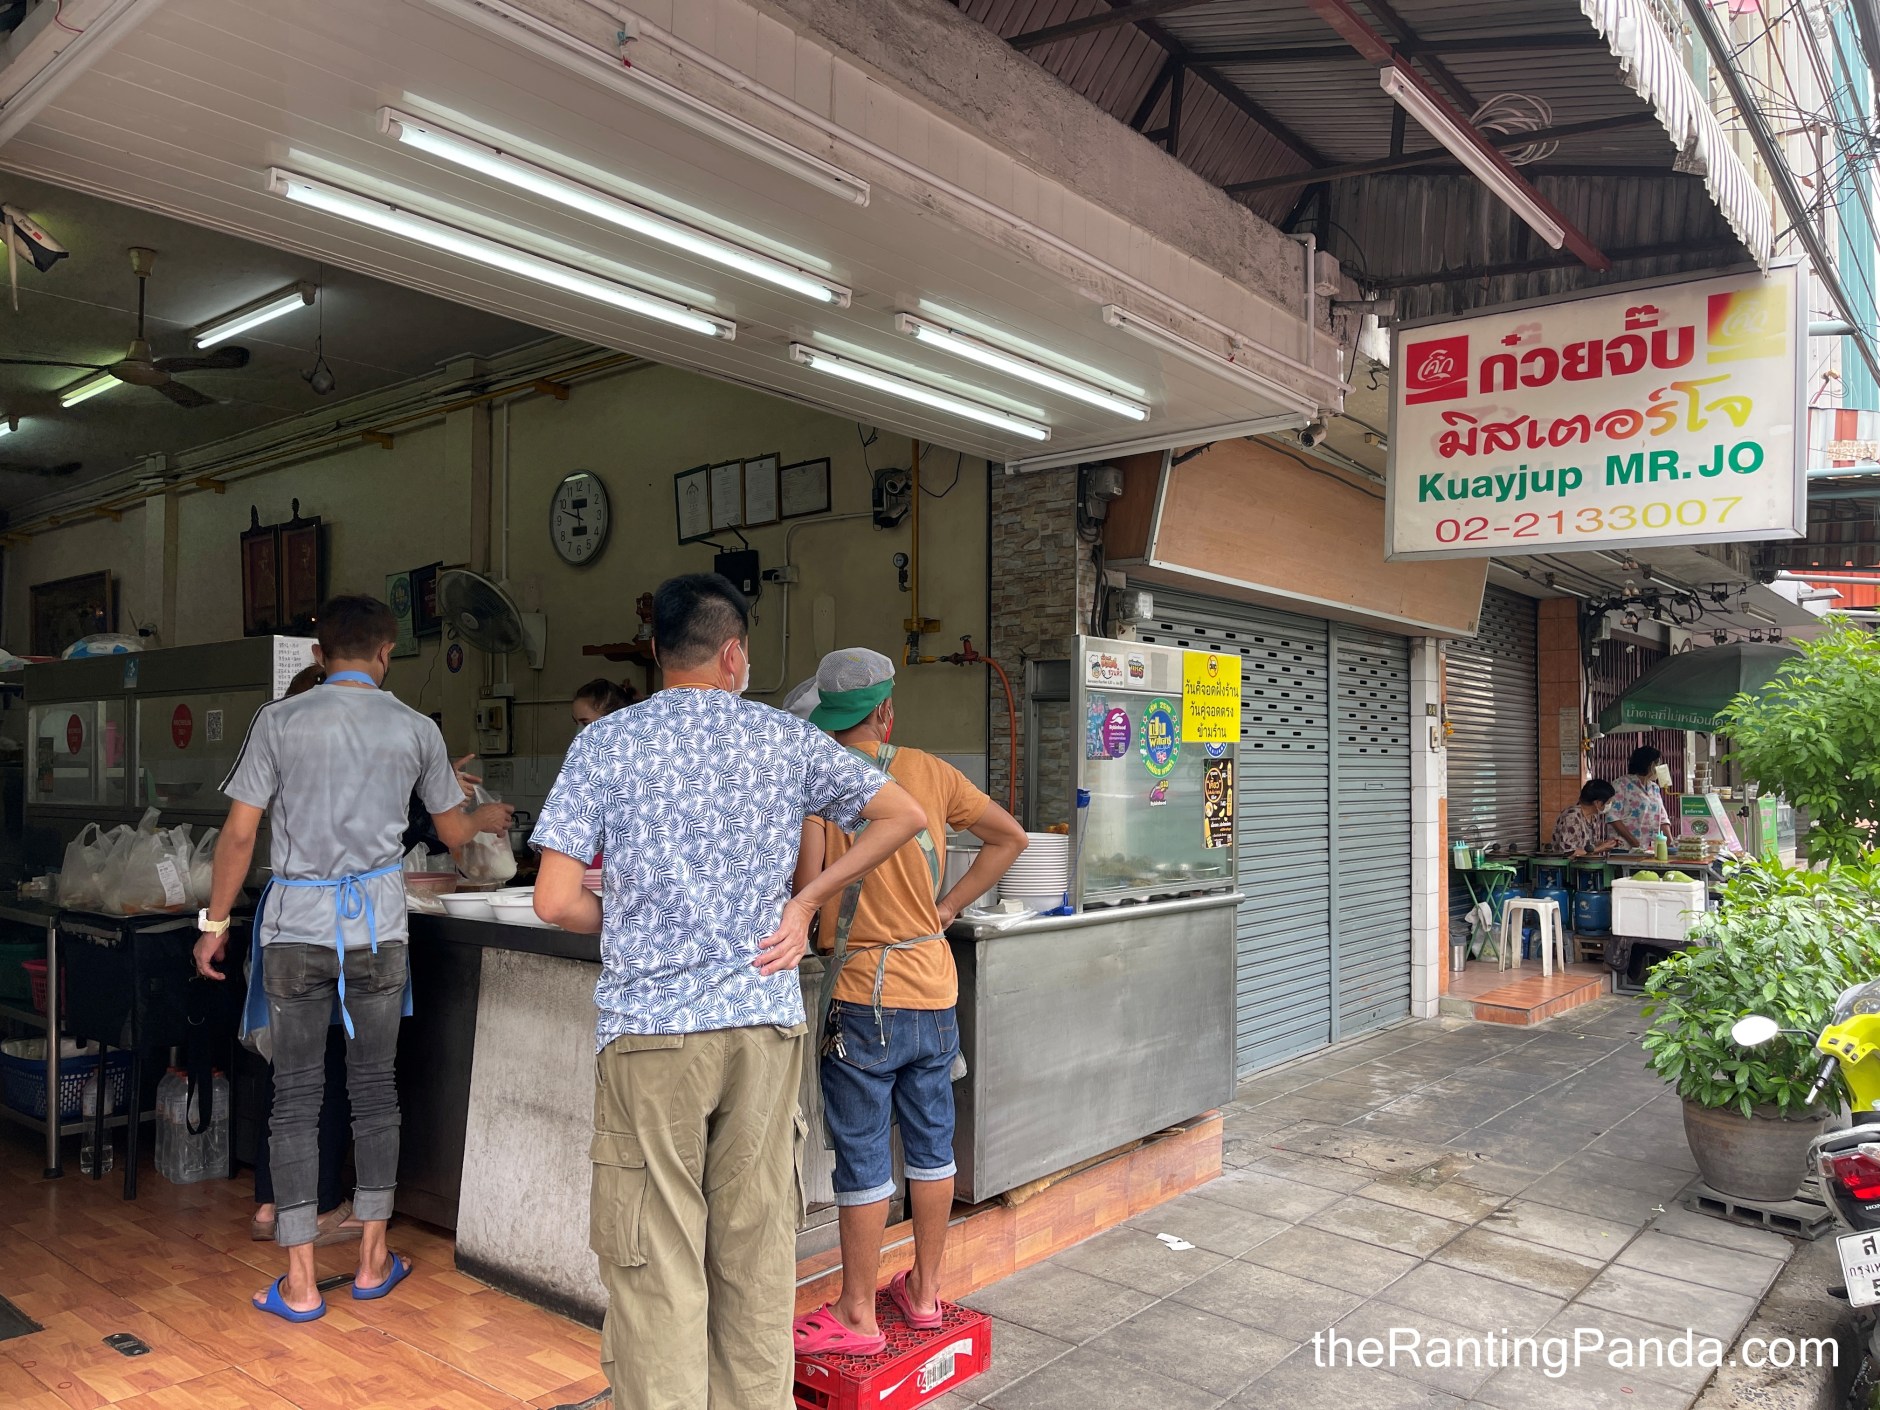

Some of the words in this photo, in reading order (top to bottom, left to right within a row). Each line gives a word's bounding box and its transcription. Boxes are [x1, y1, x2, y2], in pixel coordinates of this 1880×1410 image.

[1479, 304, 1696, 394] ก๋วยจั๊บ
[1438, 374, 1754, 458] มิสเตอร์โจ
[576, 480, 583, 491] 12
[1418, 464, 1583, 503] Kuayjup
[1605, 441, 1765, 487] MR.JO
[1435, 496, 1744, 543] 02-2133007
